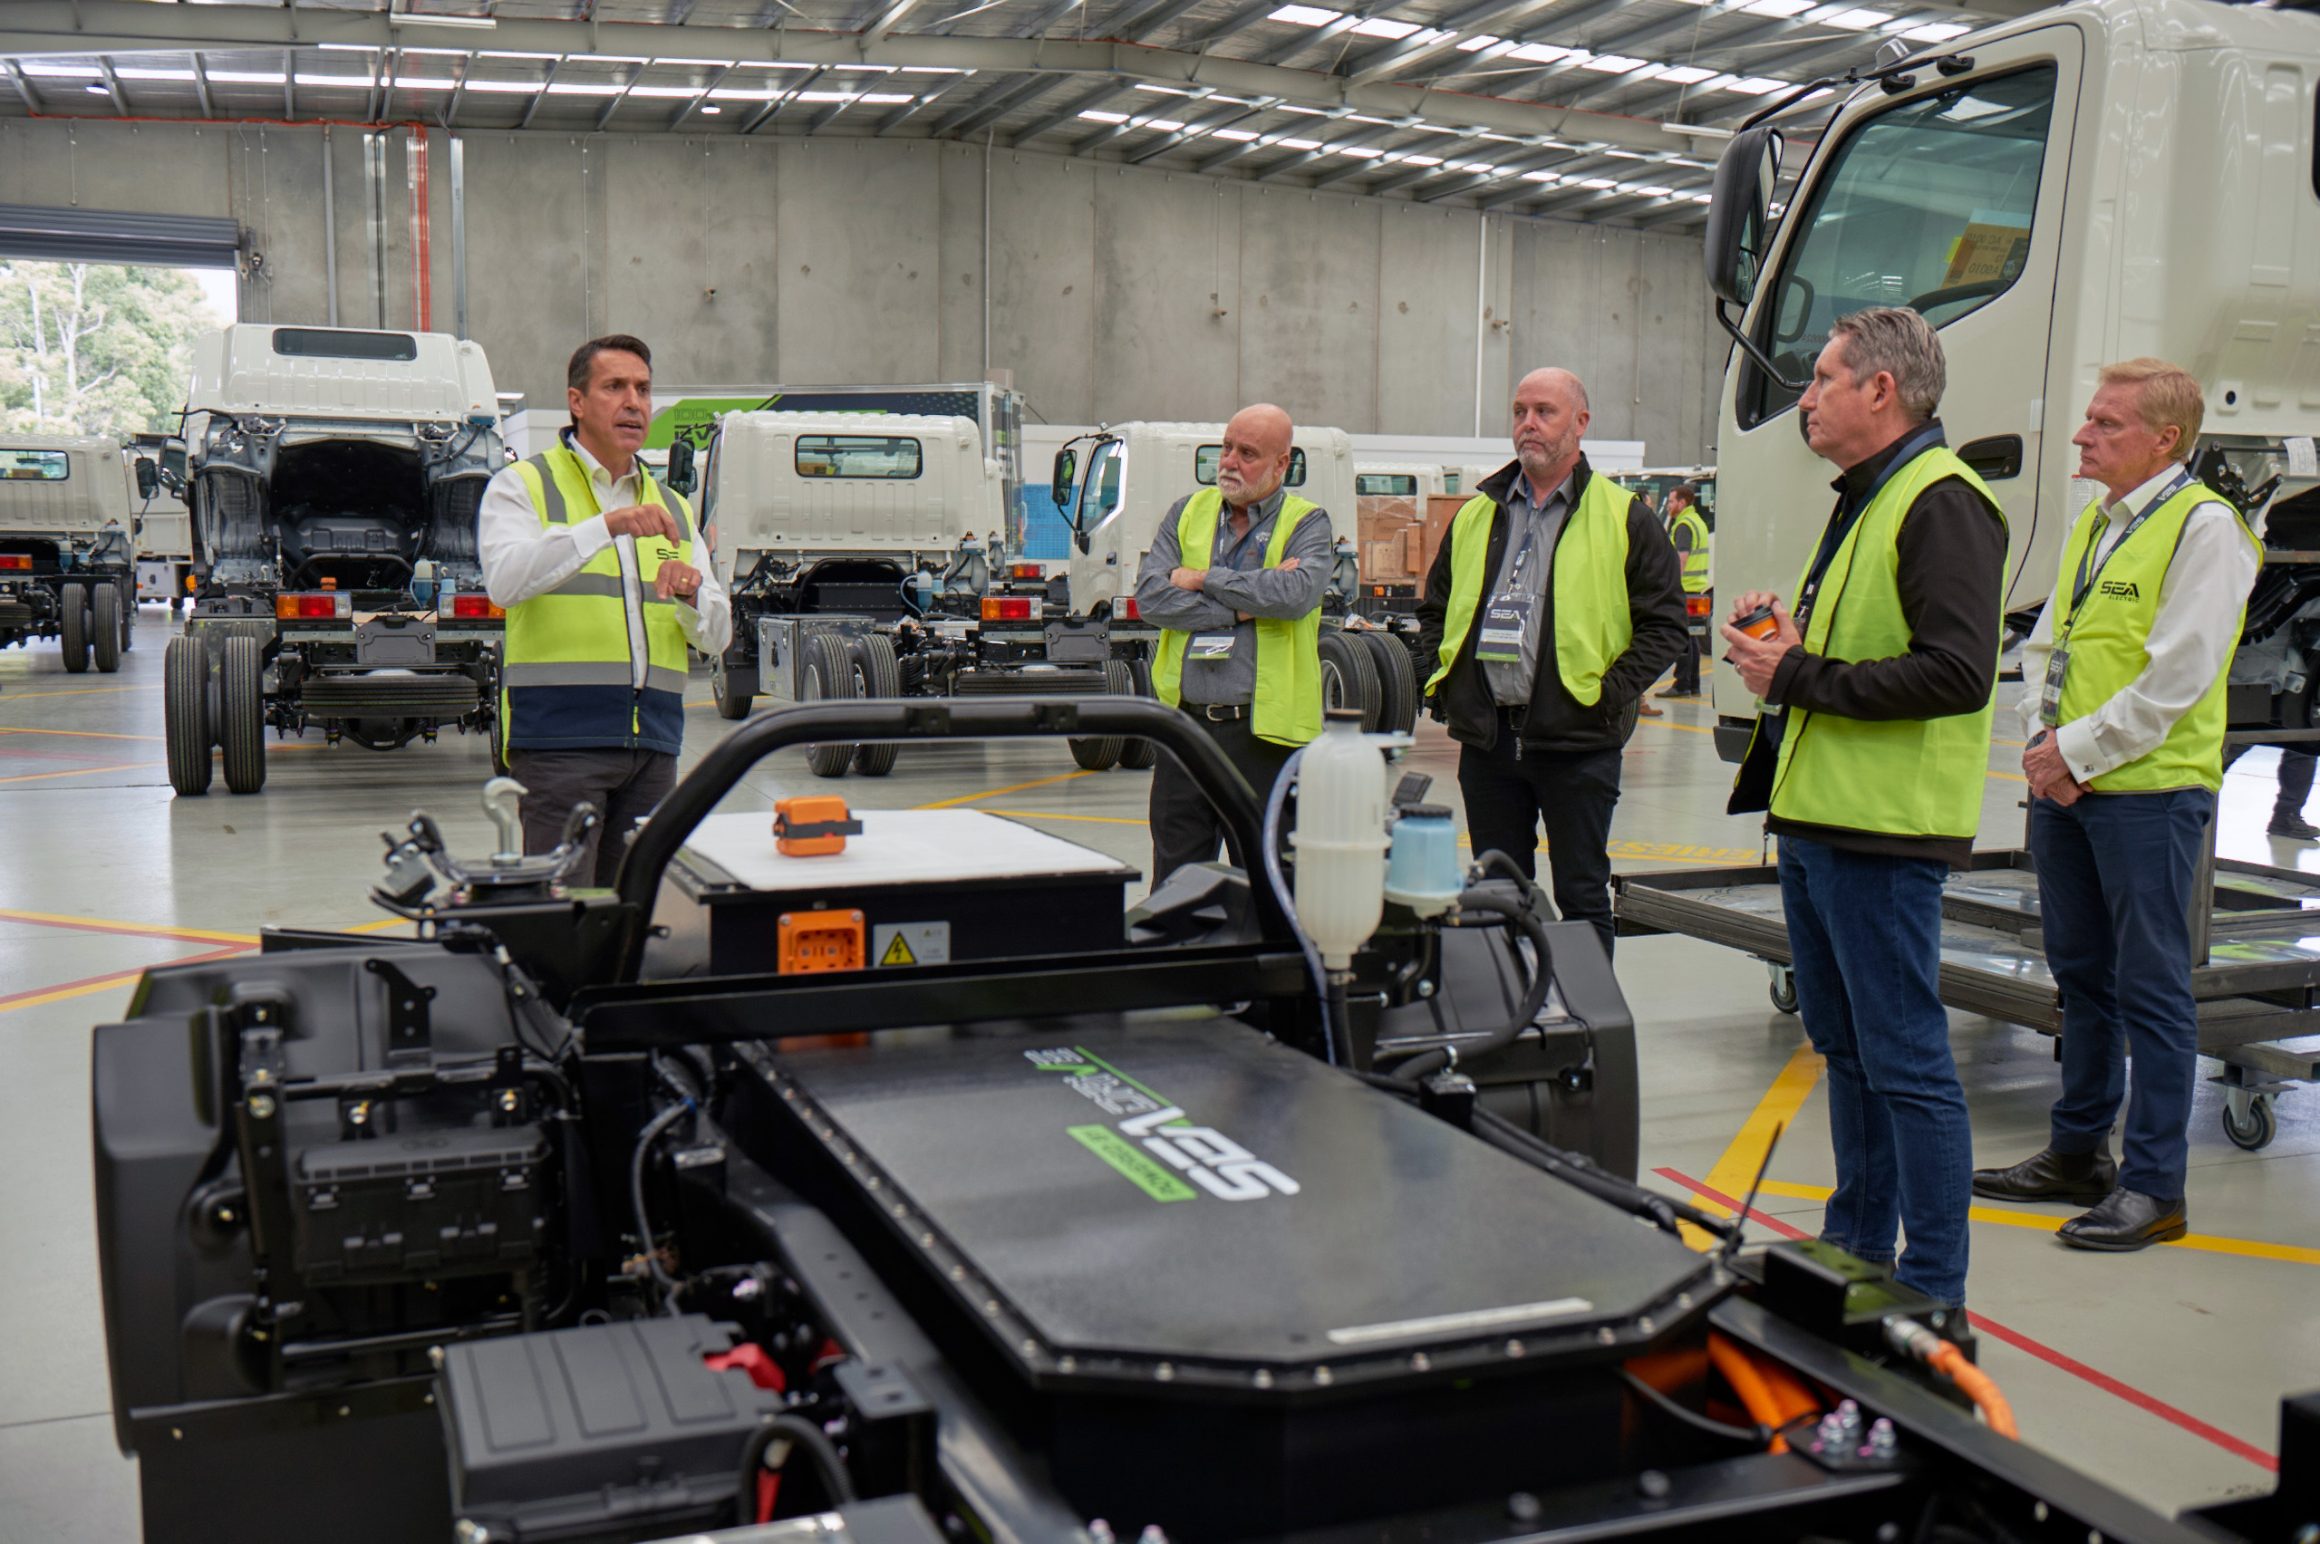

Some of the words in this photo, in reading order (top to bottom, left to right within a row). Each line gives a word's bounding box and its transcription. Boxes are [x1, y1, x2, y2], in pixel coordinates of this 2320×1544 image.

[2100, 580, 2140, 598] SEA
[2108, 594, 2140, 604] ELECTRIC
[1490, 608, 1521, 620] SEA
